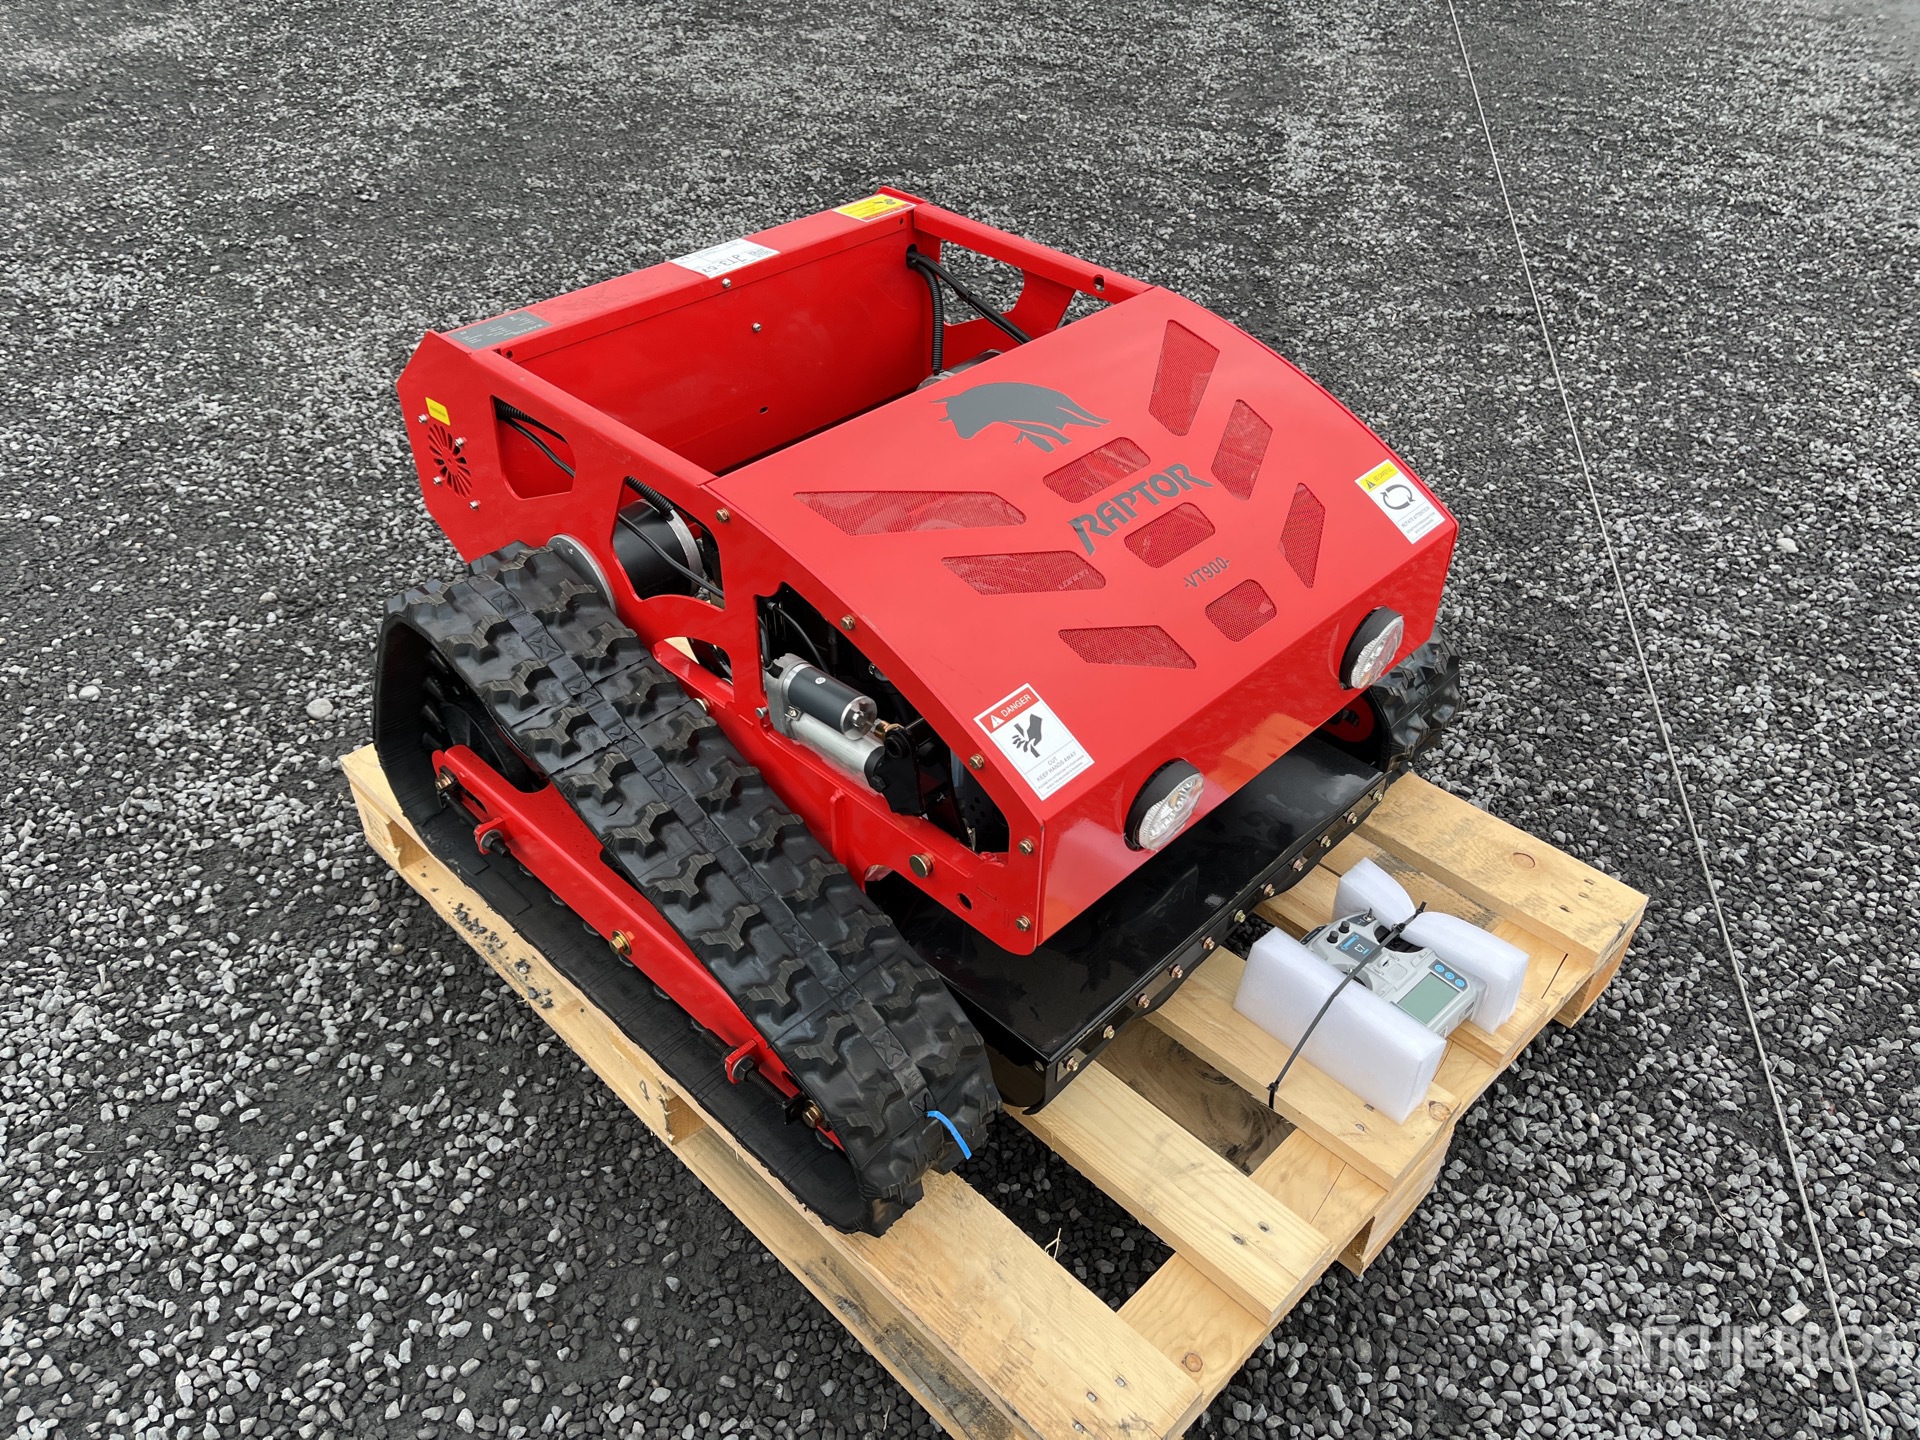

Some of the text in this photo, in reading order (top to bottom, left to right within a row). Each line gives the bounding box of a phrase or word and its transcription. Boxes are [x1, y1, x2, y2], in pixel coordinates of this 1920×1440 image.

[1068, 463, 1213, 556] RAPTOR
[1000, 694, 1031, 717] DANGER
[1036, 770, 1049, 782] KEEP
[1048, 760, 1065, 773] HANDS
[1063, 751, 1077, 762] AWAY
[1047, 756, 1058, 766] CUT
